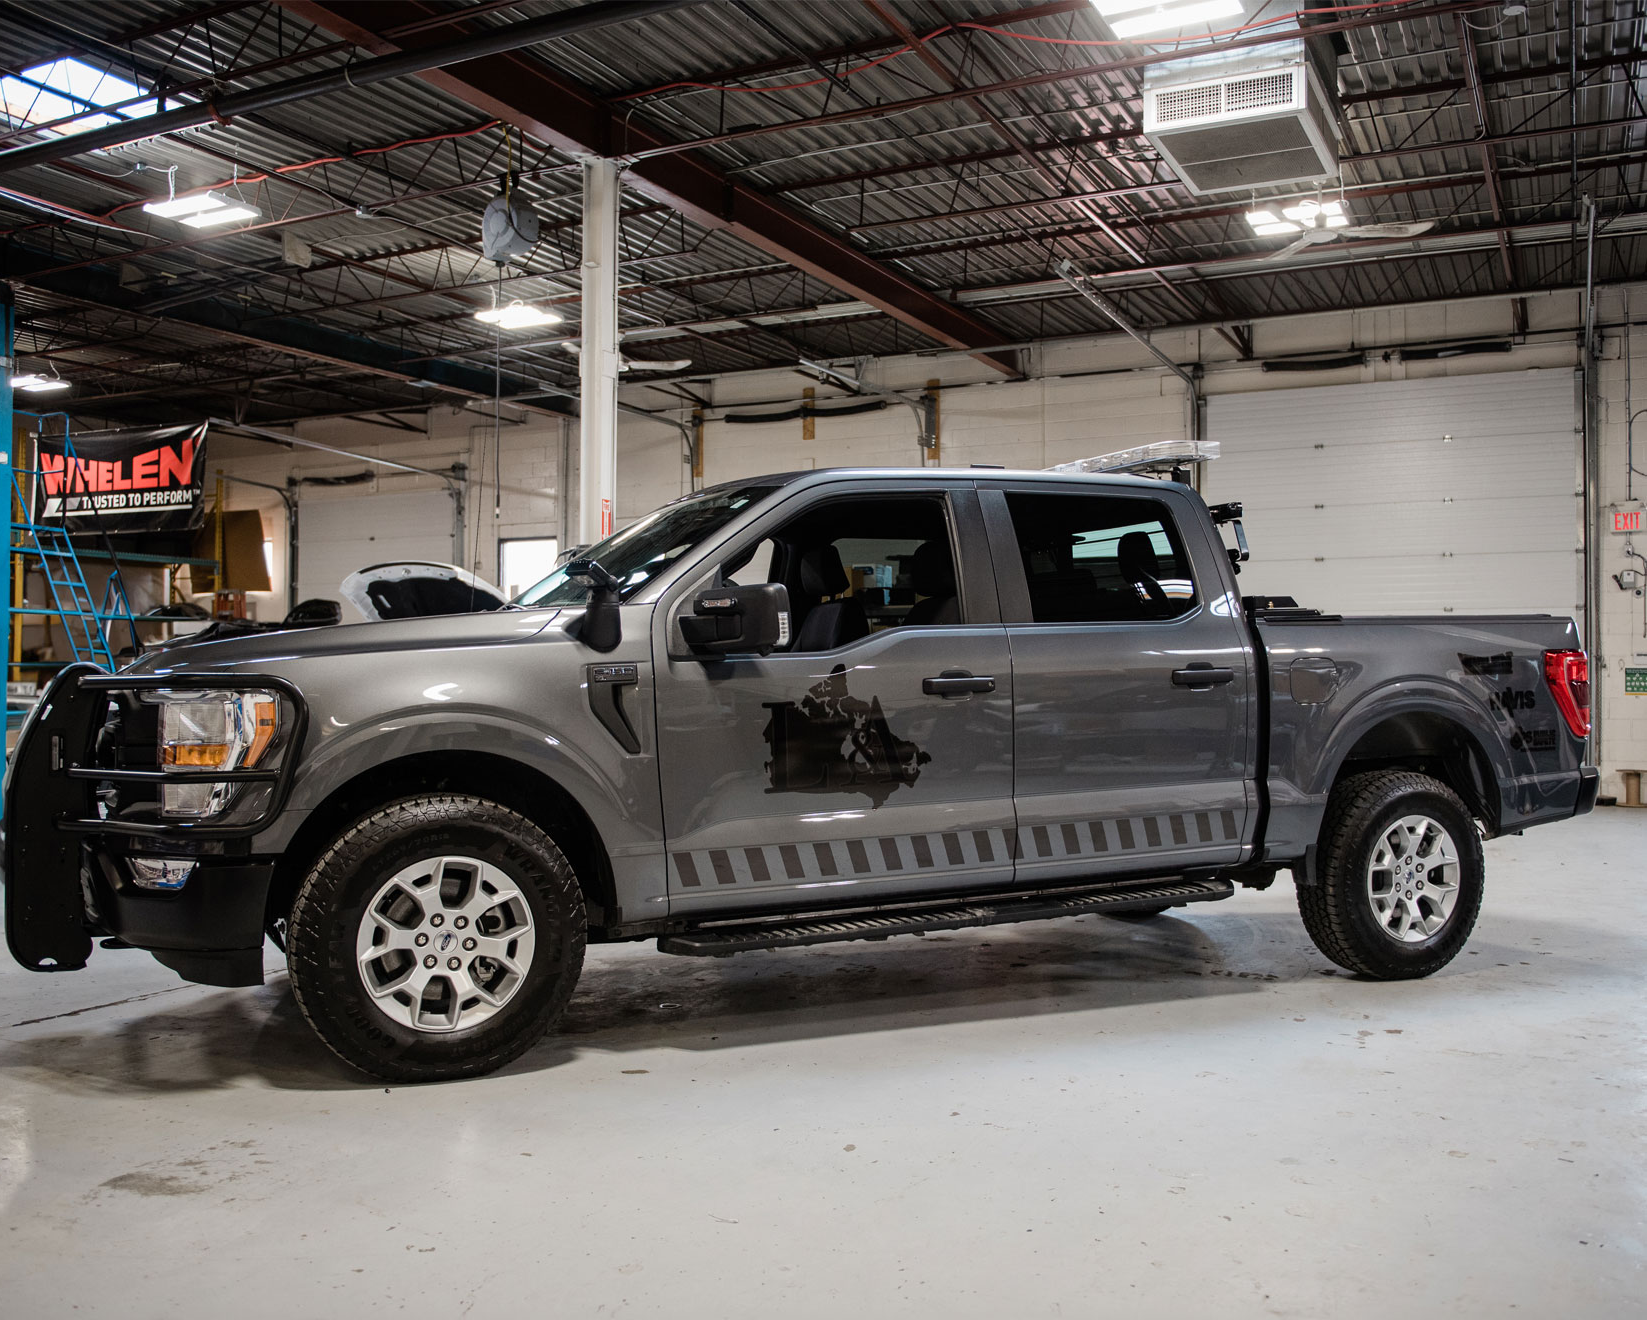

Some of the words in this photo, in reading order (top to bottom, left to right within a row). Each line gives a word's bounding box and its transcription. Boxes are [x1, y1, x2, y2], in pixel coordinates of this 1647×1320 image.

[40, 438, 194, 495] WHELEN
[128, 493, 142, 507] TO
[1614, 512, 1641, 530] EXIT
[1489, 687, 1536, 718] HAVIS
